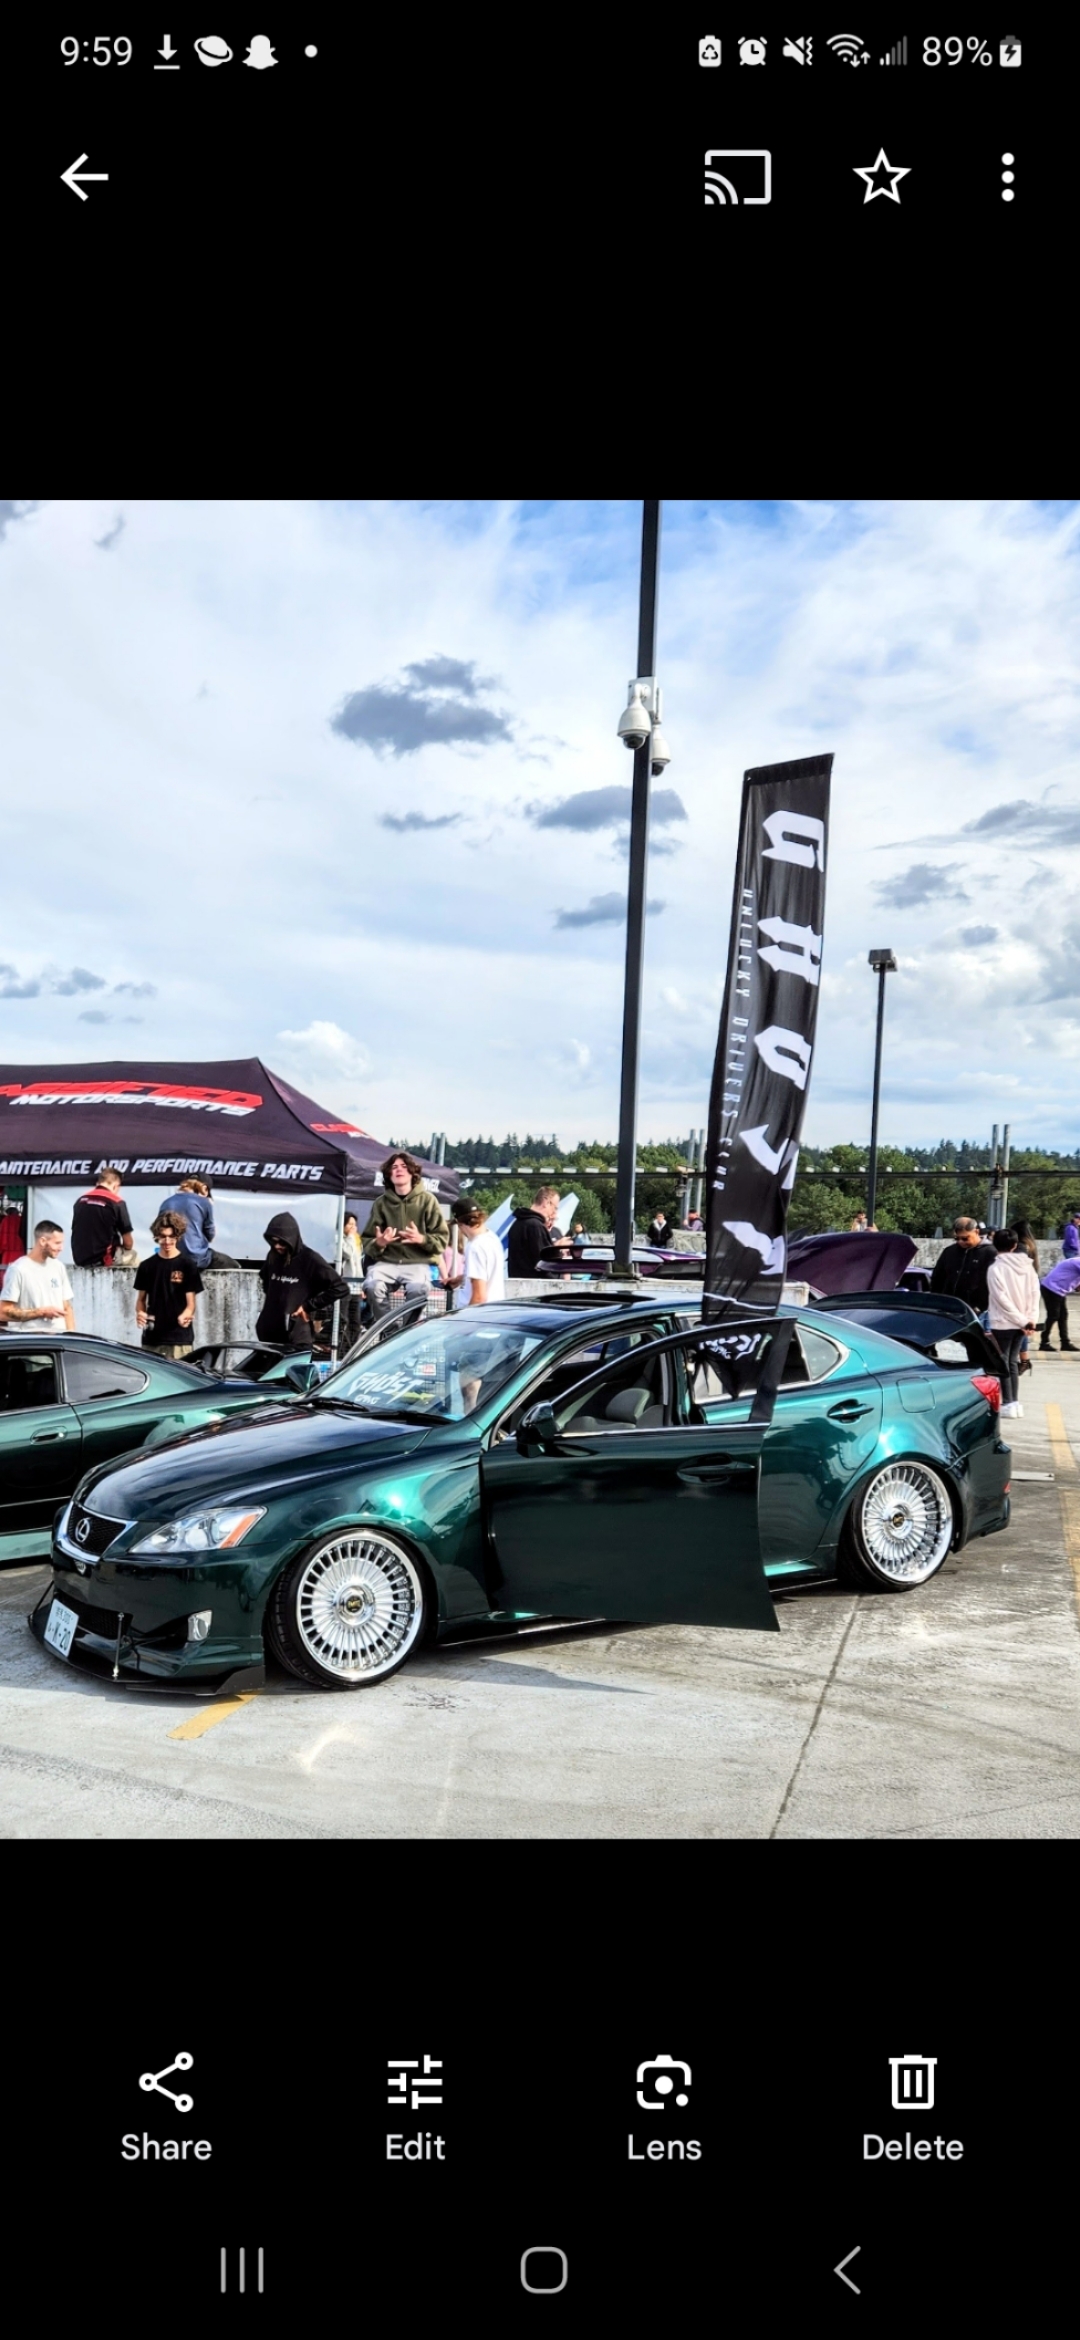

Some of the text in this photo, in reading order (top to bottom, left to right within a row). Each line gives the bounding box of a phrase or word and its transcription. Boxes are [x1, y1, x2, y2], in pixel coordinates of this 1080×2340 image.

[735, 888, 754, 998] UNLUCKY
[721, 1015, 750, 1120] DRIVERS
[9, 1093, 256, 1117] MOTORSPORTS
[131, 1159, 259, 1178] PERFORMANCE
[261, 1163, 325, 1182] PARTS
[347, 1371, 426, 1405] GHOST
